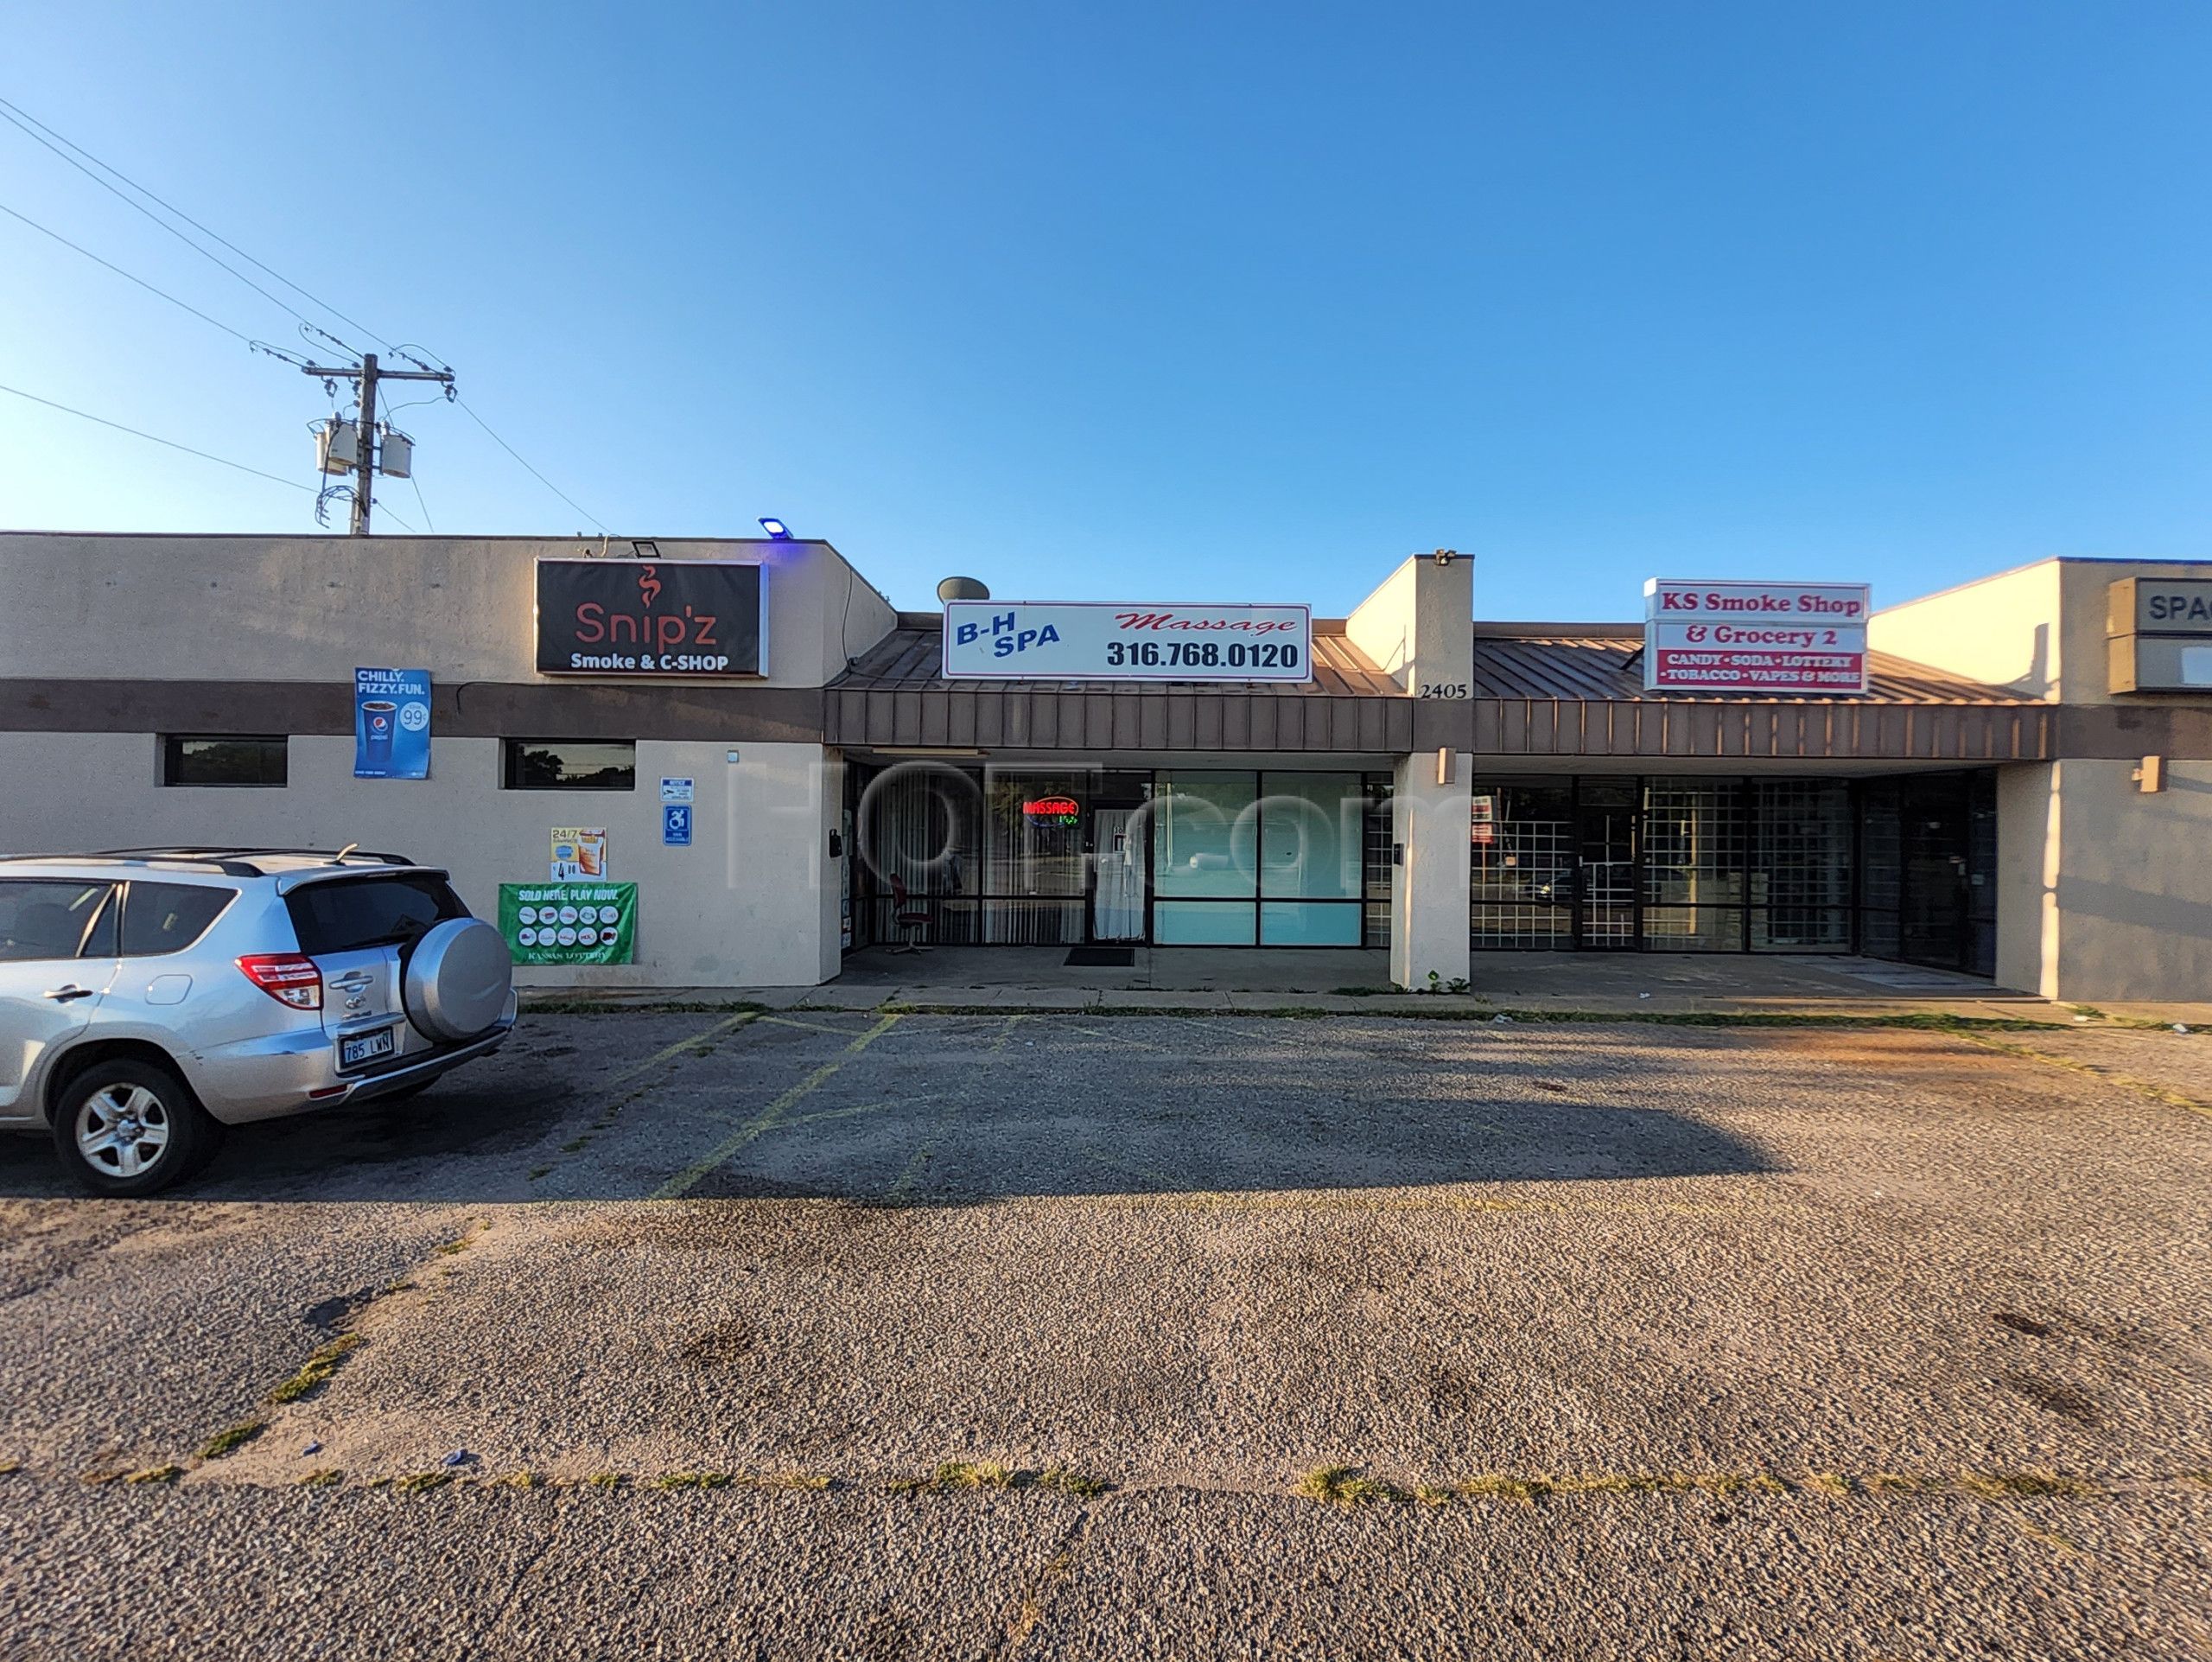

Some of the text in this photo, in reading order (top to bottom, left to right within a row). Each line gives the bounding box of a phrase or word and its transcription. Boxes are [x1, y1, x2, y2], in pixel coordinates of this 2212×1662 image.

[1662, 592, 1861, 617] KS Smoke Shop
[2149, 595, 2212, 620] SPA
[575, 602, 716, 654] Snip'z
[957, 611, 1016, 646] B-H
[1114, 612, 1298, 636] Massage
[993, 624, 1060, 658] SPA
[1686, 624, 1837, 648] & Grocery 2
[570, 653, 728, 671] Smoke & C-SHOP
[1107, 641, 1299, 669] 316.768.0120
[1667, 653, 1852, 667] CANDY SODA LOTTERY
[358, 671, 404, 683] CHILLY.
[1668, 669, 1741, 680] TOBACCO
[1749, 671, 1798, 682] VAPES
[1421, 684, 1467, 699] 2405
[1023, 801, 1075, 814] MASSAGE
[552, 830, 577, 838] 24/7
[518, 889, 542, 901] SOLD
[570, 888, 594, 901] PLAY
[346, 1042, 365, 1061] 785
